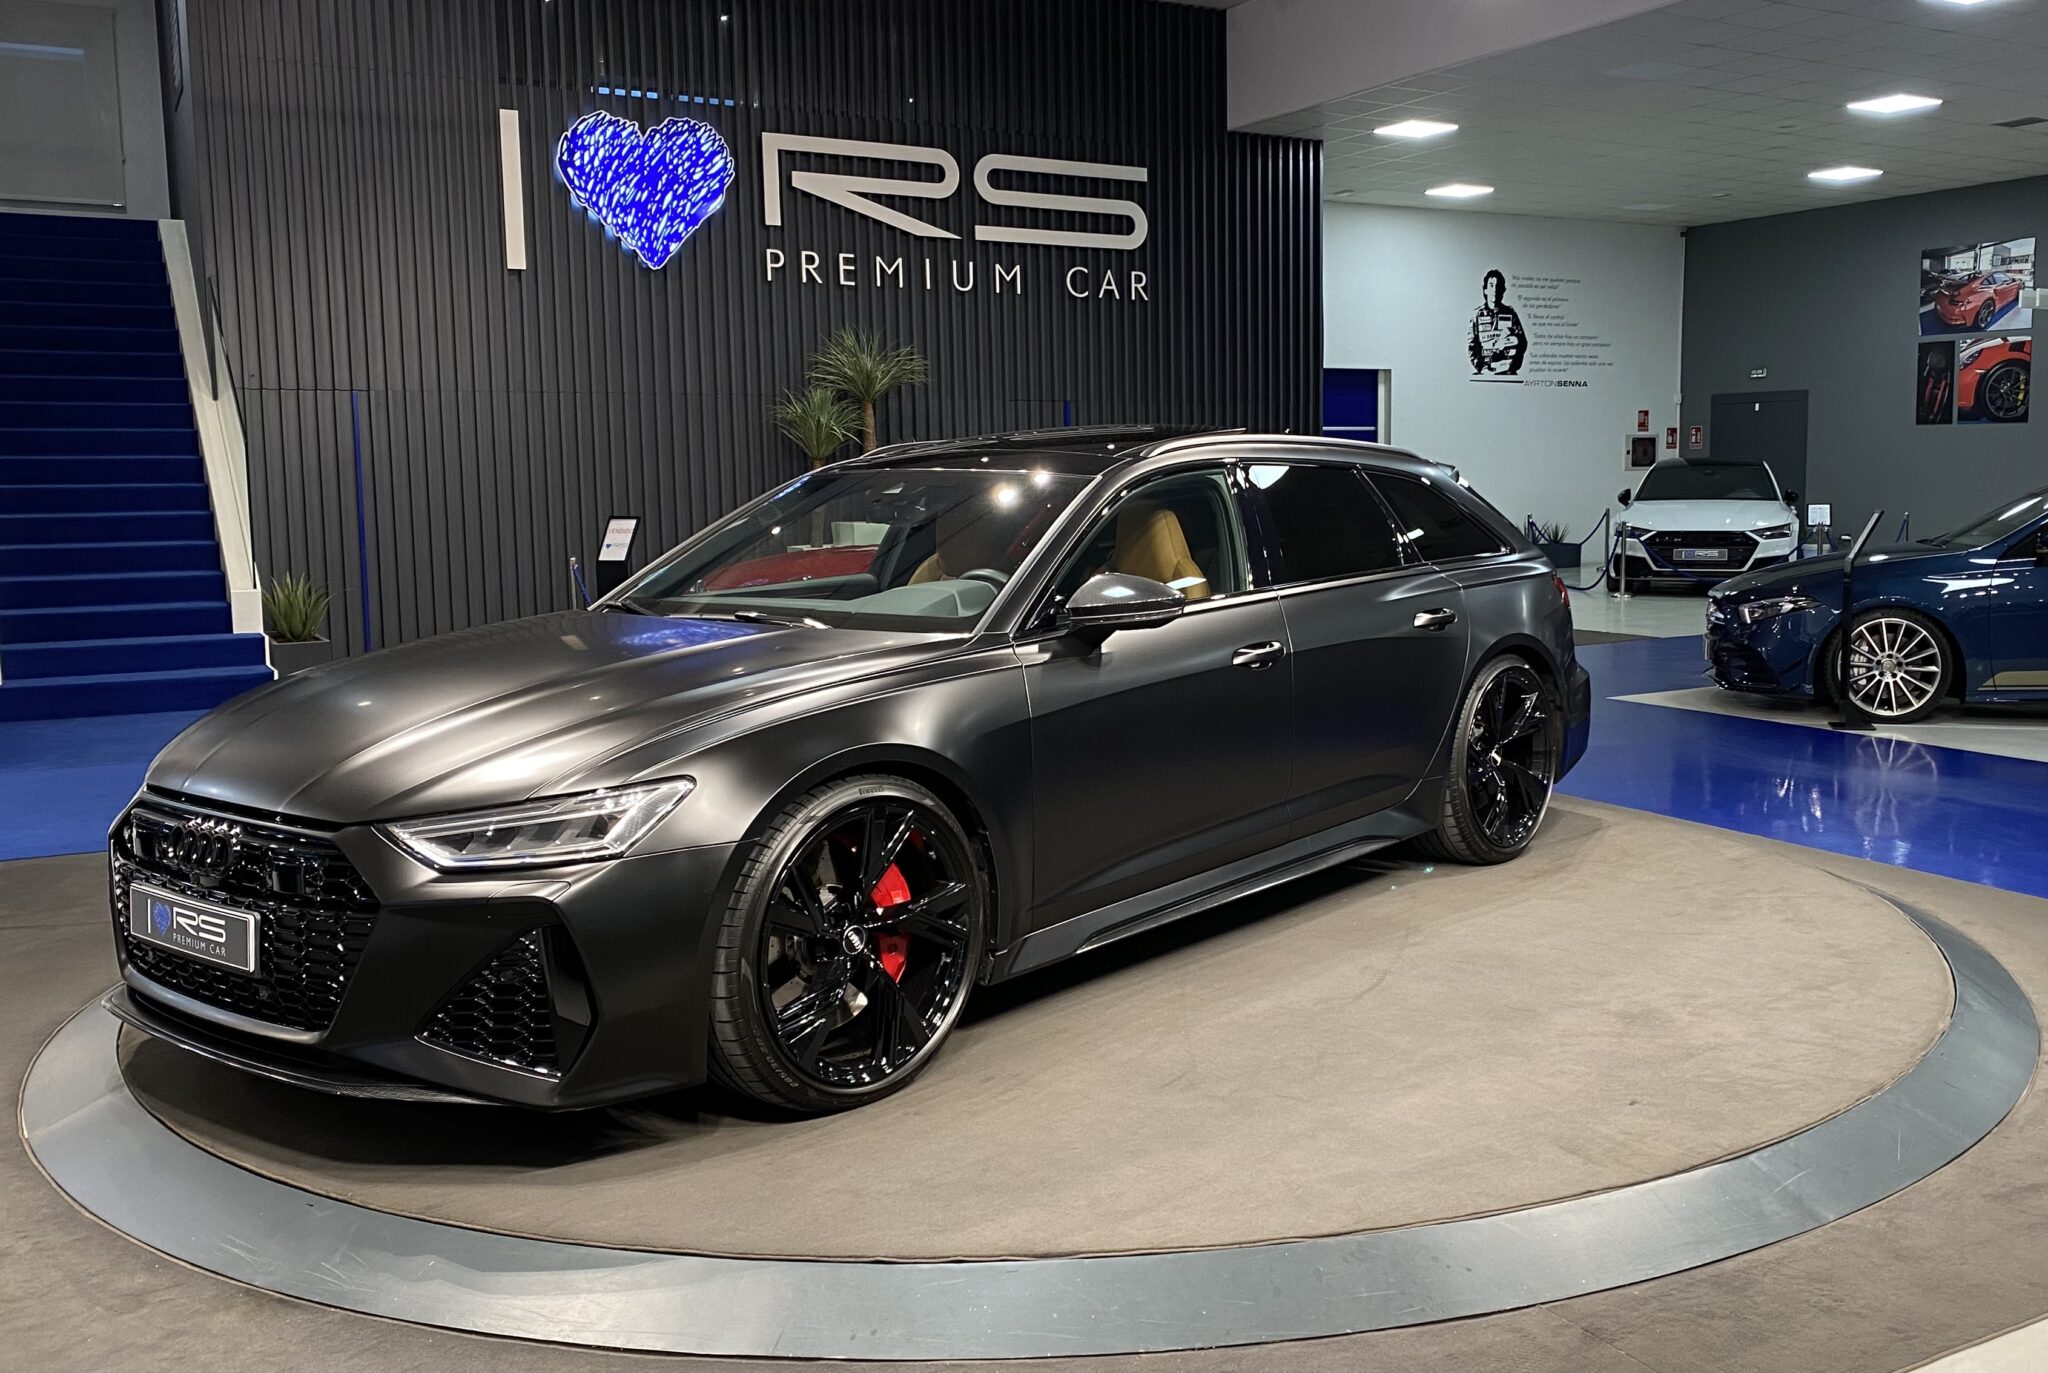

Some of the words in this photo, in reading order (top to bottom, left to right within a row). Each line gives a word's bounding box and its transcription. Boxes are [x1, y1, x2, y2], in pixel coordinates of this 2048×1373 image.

[499, 109, 527, 270] I
[762, 131, 1149, 250] RS
[766, 248, 1022, 295] PREMIUM
[1066, 266, 1149, 301] CAR
[173, 907, 226, 943] RS
[173, 933, 205, 951] PREMIUM
[210, 944, 226, 956] CAR
